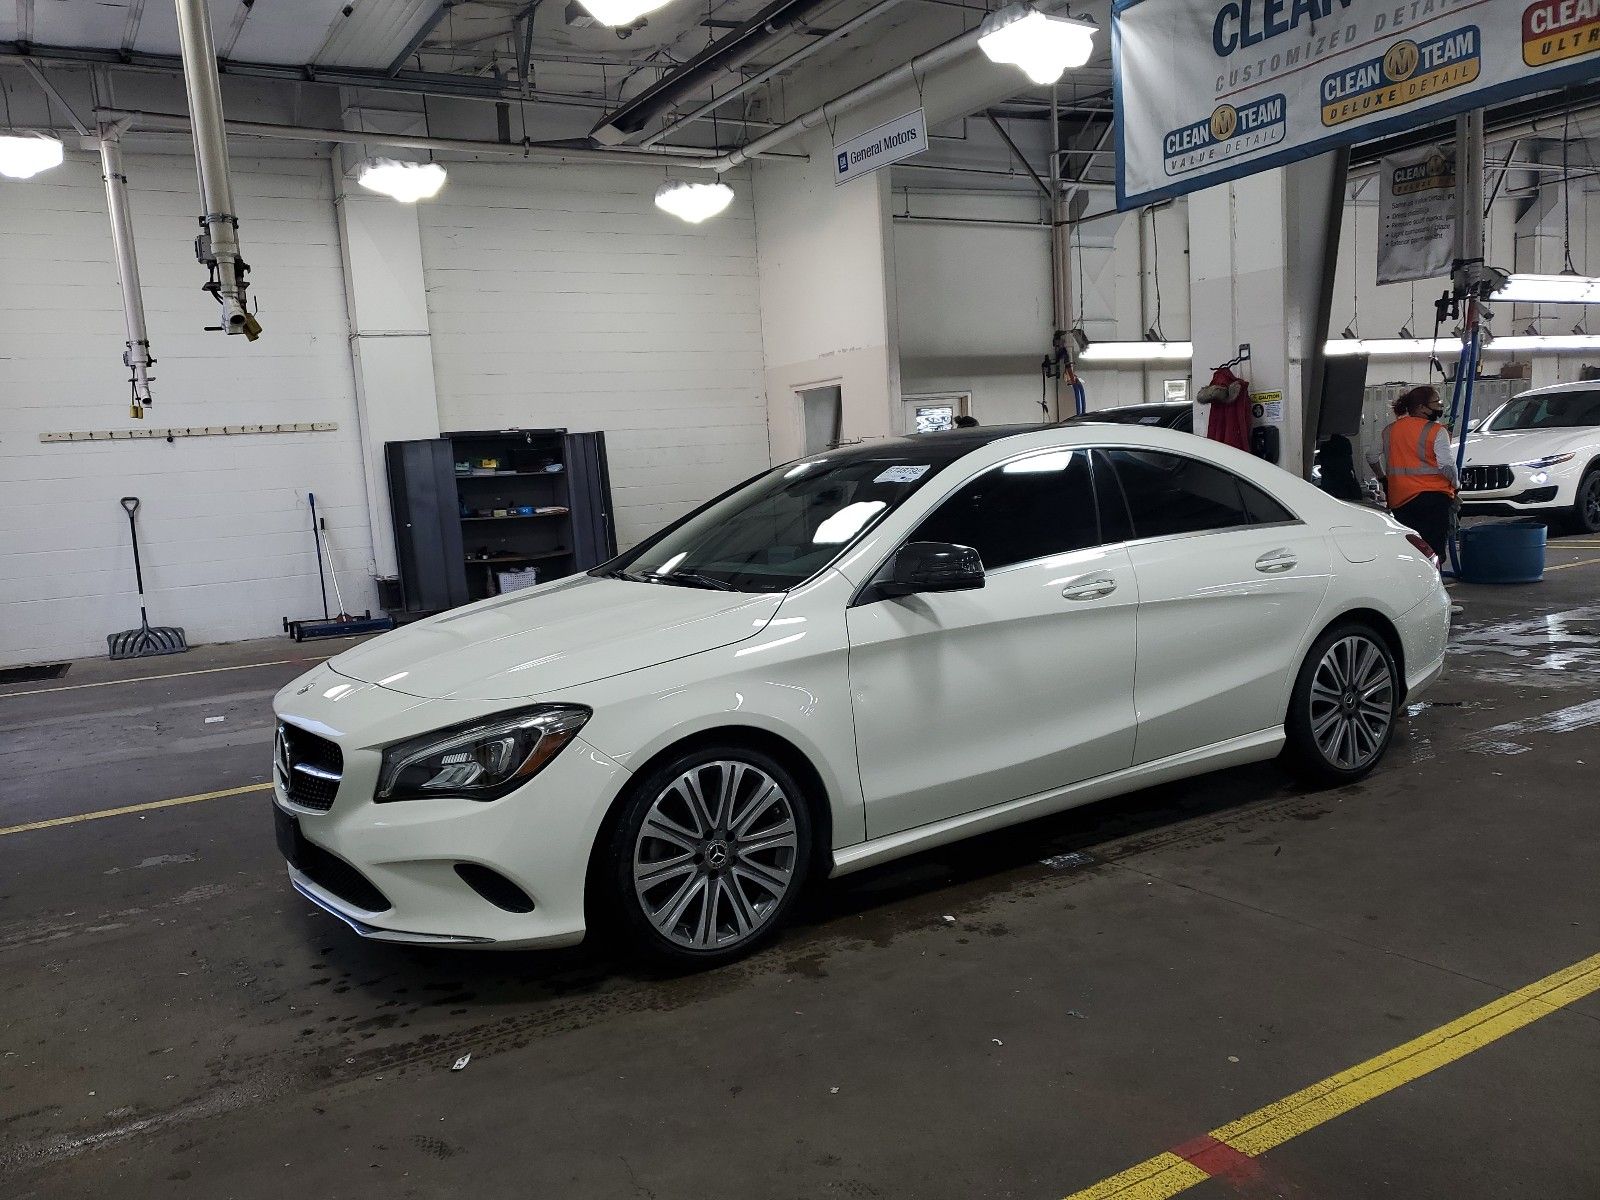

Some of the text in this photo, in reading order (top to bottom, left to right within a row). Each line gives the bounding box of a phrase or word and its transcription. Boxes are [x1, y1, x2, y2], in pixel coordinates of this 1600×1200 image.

[1215, 0, 1463, 93] CUSTOMIZED DETA
[1325, 62, 1380, 100] CLEAN
[1421, 30, 1474, 69] TEAM
[1330, 65, 1468, 120] DELUXE DETAIL
[850, 128, 917, 165] General Motors
[1166, 124, 1209, 154] CLEAN
[1239, 98, 1281, 130] TEAM
[1171, 129, 1276, 169] VALUE DETAIL
[1395, 166, 1426, 182] CLEAN
